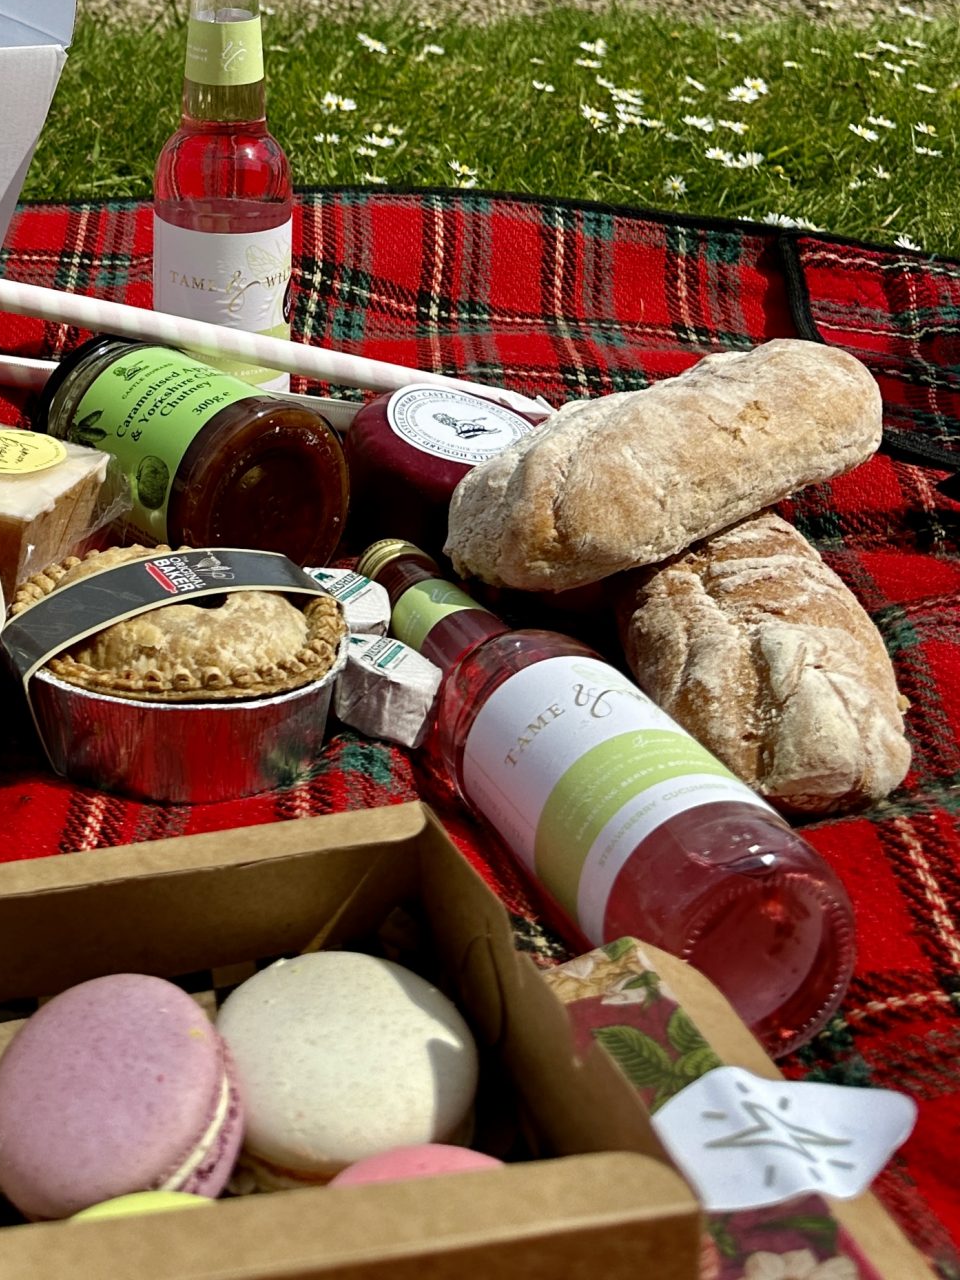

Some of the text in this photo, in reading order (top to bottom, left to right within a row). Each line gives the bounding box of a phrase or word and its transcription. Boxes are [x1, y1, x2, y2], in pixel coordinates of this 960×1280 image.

[169, 270, 218, 293] TAME
[116, 371, 180, 438] Caramelised
[130, 429, 143, 442] &
[138, 378, 192, 424] Yorkshire
[159, 380, 213, 417] Chutney
[192, 394, 224, 416] 300g
[153, 558, 196, 592] BAKER
[169, 557, 207, 588] ORIGINAL
[504, 703, 566, 768] TAME
[597, 800, 657, 867] STRAWBERRY
